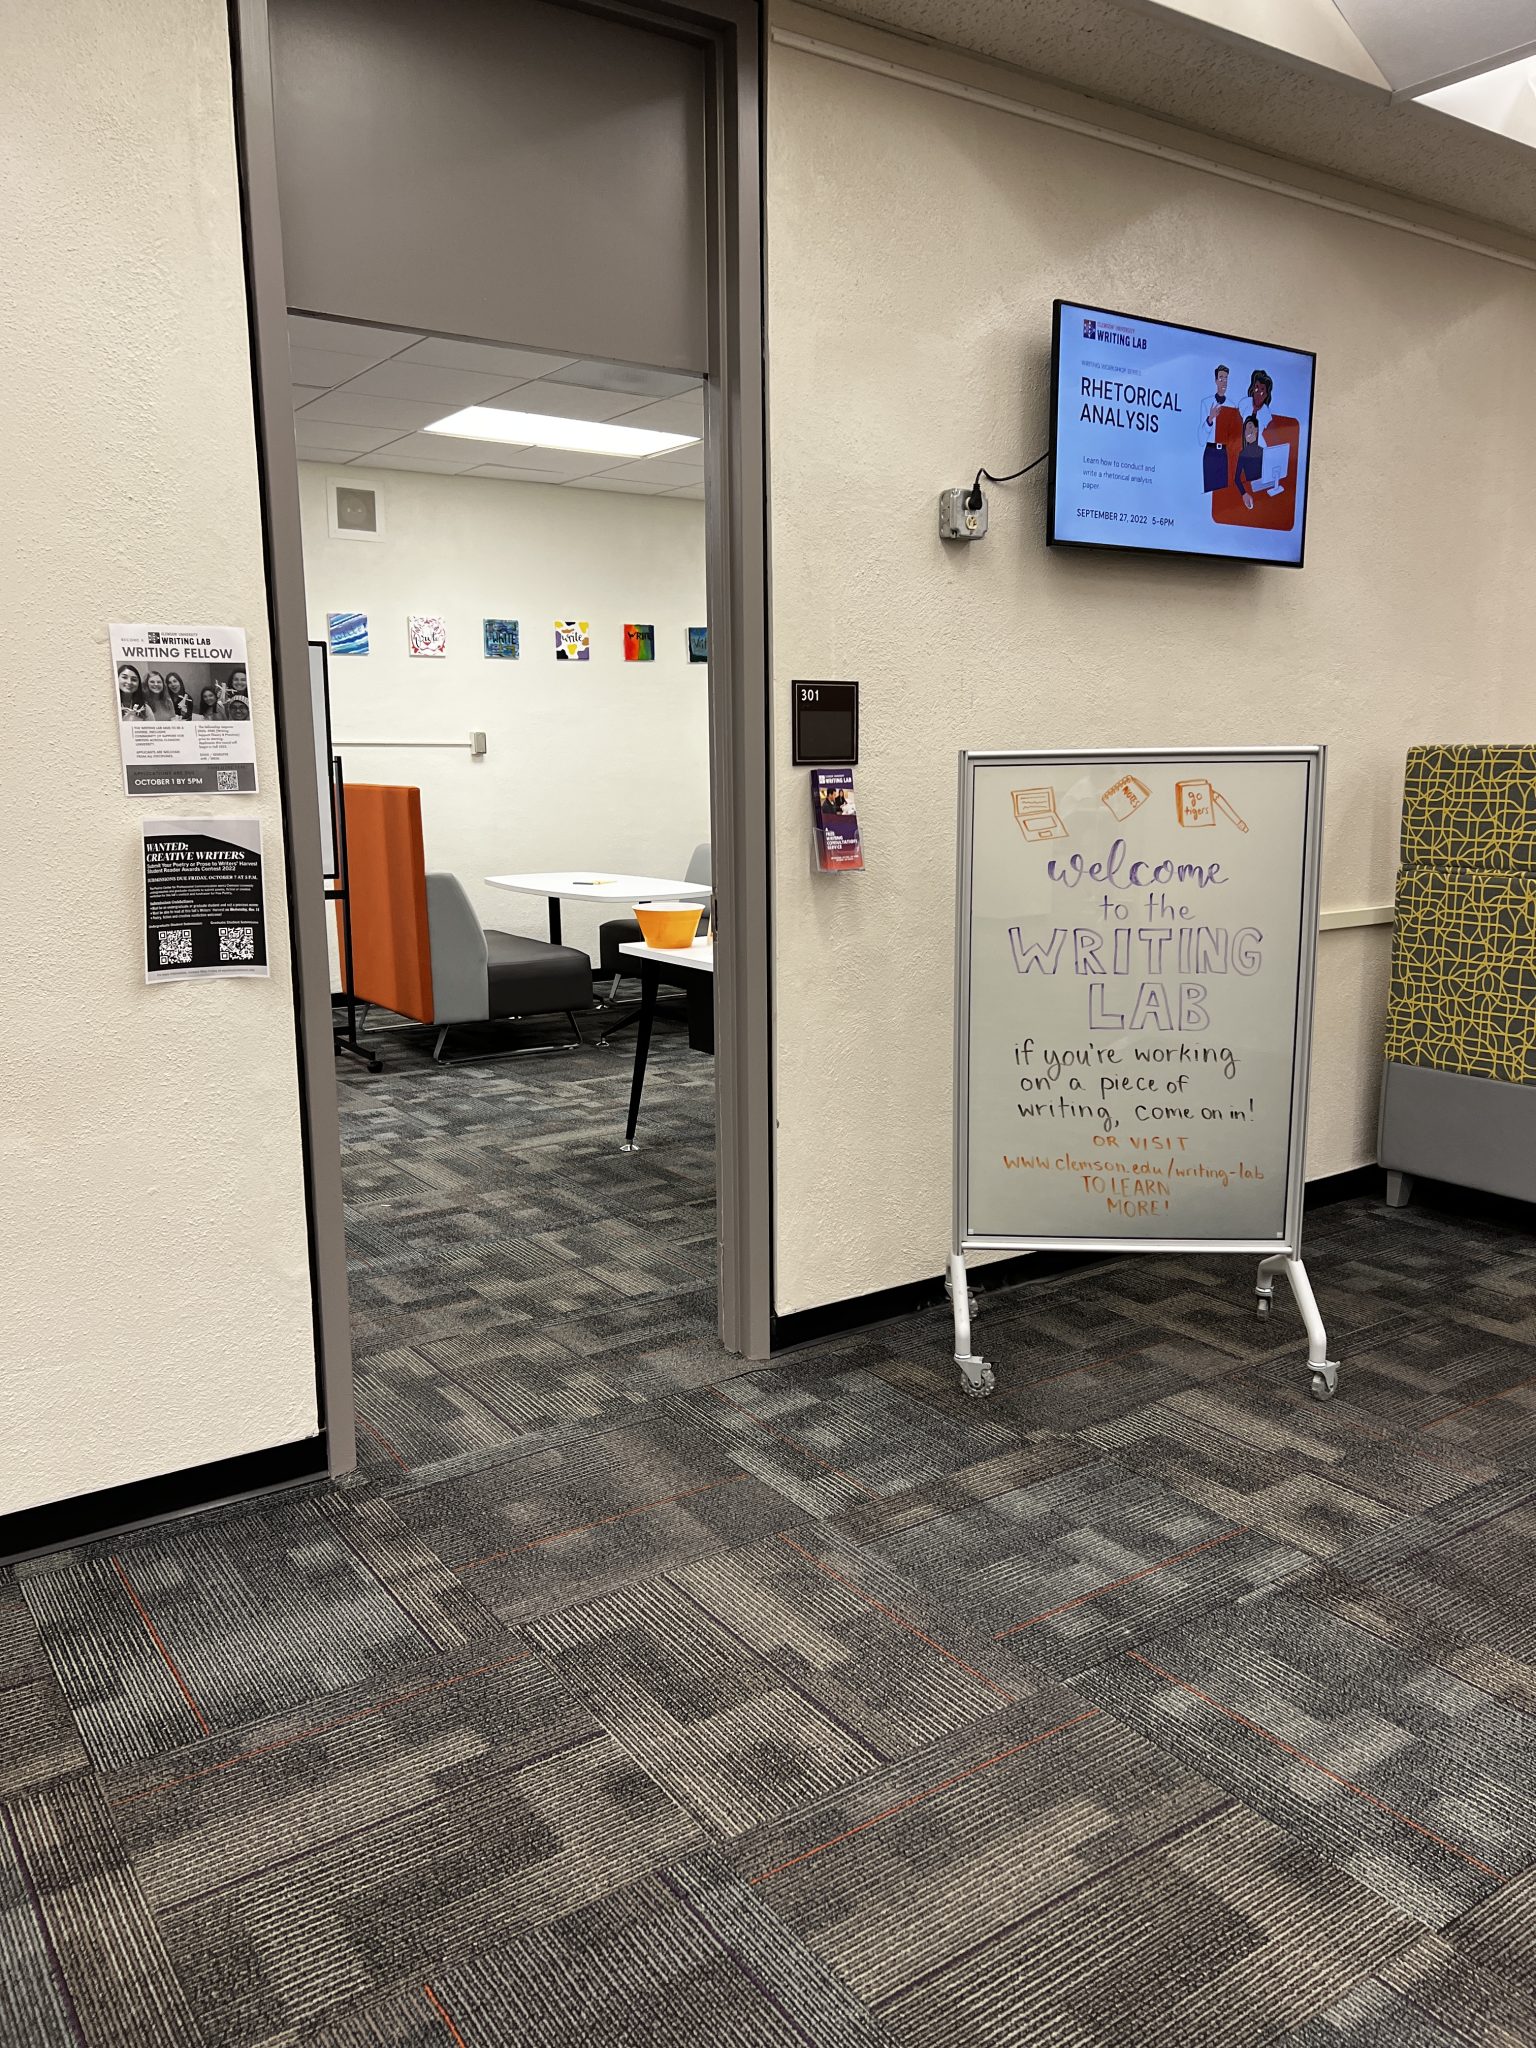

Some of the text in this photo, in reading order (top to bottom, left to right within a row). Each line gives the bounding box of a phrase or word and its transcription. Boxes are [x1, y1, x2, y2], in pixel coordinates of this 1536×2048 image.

[1097, 330, 1147, 349] WRITING LAB
[1081, 376, 1182, 412] RHETORICAL
[1080, 403, 1159, 433] ANALYSIS
[1083, 456, 1156, 473] Learn how to conduct and
[1083, 469, 1097, 477] write
[1103, 471, 1130, 482] rhetorical
[1131, 475, 1153, 485] analysis
[1077, 508, 1175, 527] SEPTEMBER 27, 2022 5-6PM
[161, 637, 194, 645] WRITING
[122, 647, 232, 659] WRITING FELLOW
[801, 689, 819, 701] 301
[1122, 786, 1140, 808] NOTES
[1188, 791, 1203, 806] go
[1184, 805, 1209, 820] tigers
[146, 842, 189, 852] WANTED:
[146, 851, 245, 862] CREATIVE WRITERS
[1047, 839, 1229, 889] welcome
[1099, 892, 1196, 922] to the
[1008, 926, 1263, 976] WRITING
[1089, 982, 1210, 1032] LAB
[1014, 1038, 1241, 1081] if you're working
[1020, 1075, 1190, 1100] on a piece of
[1018, 1096, 1255, 1132] writing, come on in!
[1093, 1135, 1189, 1150] OR VISIT
[1082, 1175, 1170, 1197] TO LEARN
[1107, 1198, 1169, 1217] MORE!
